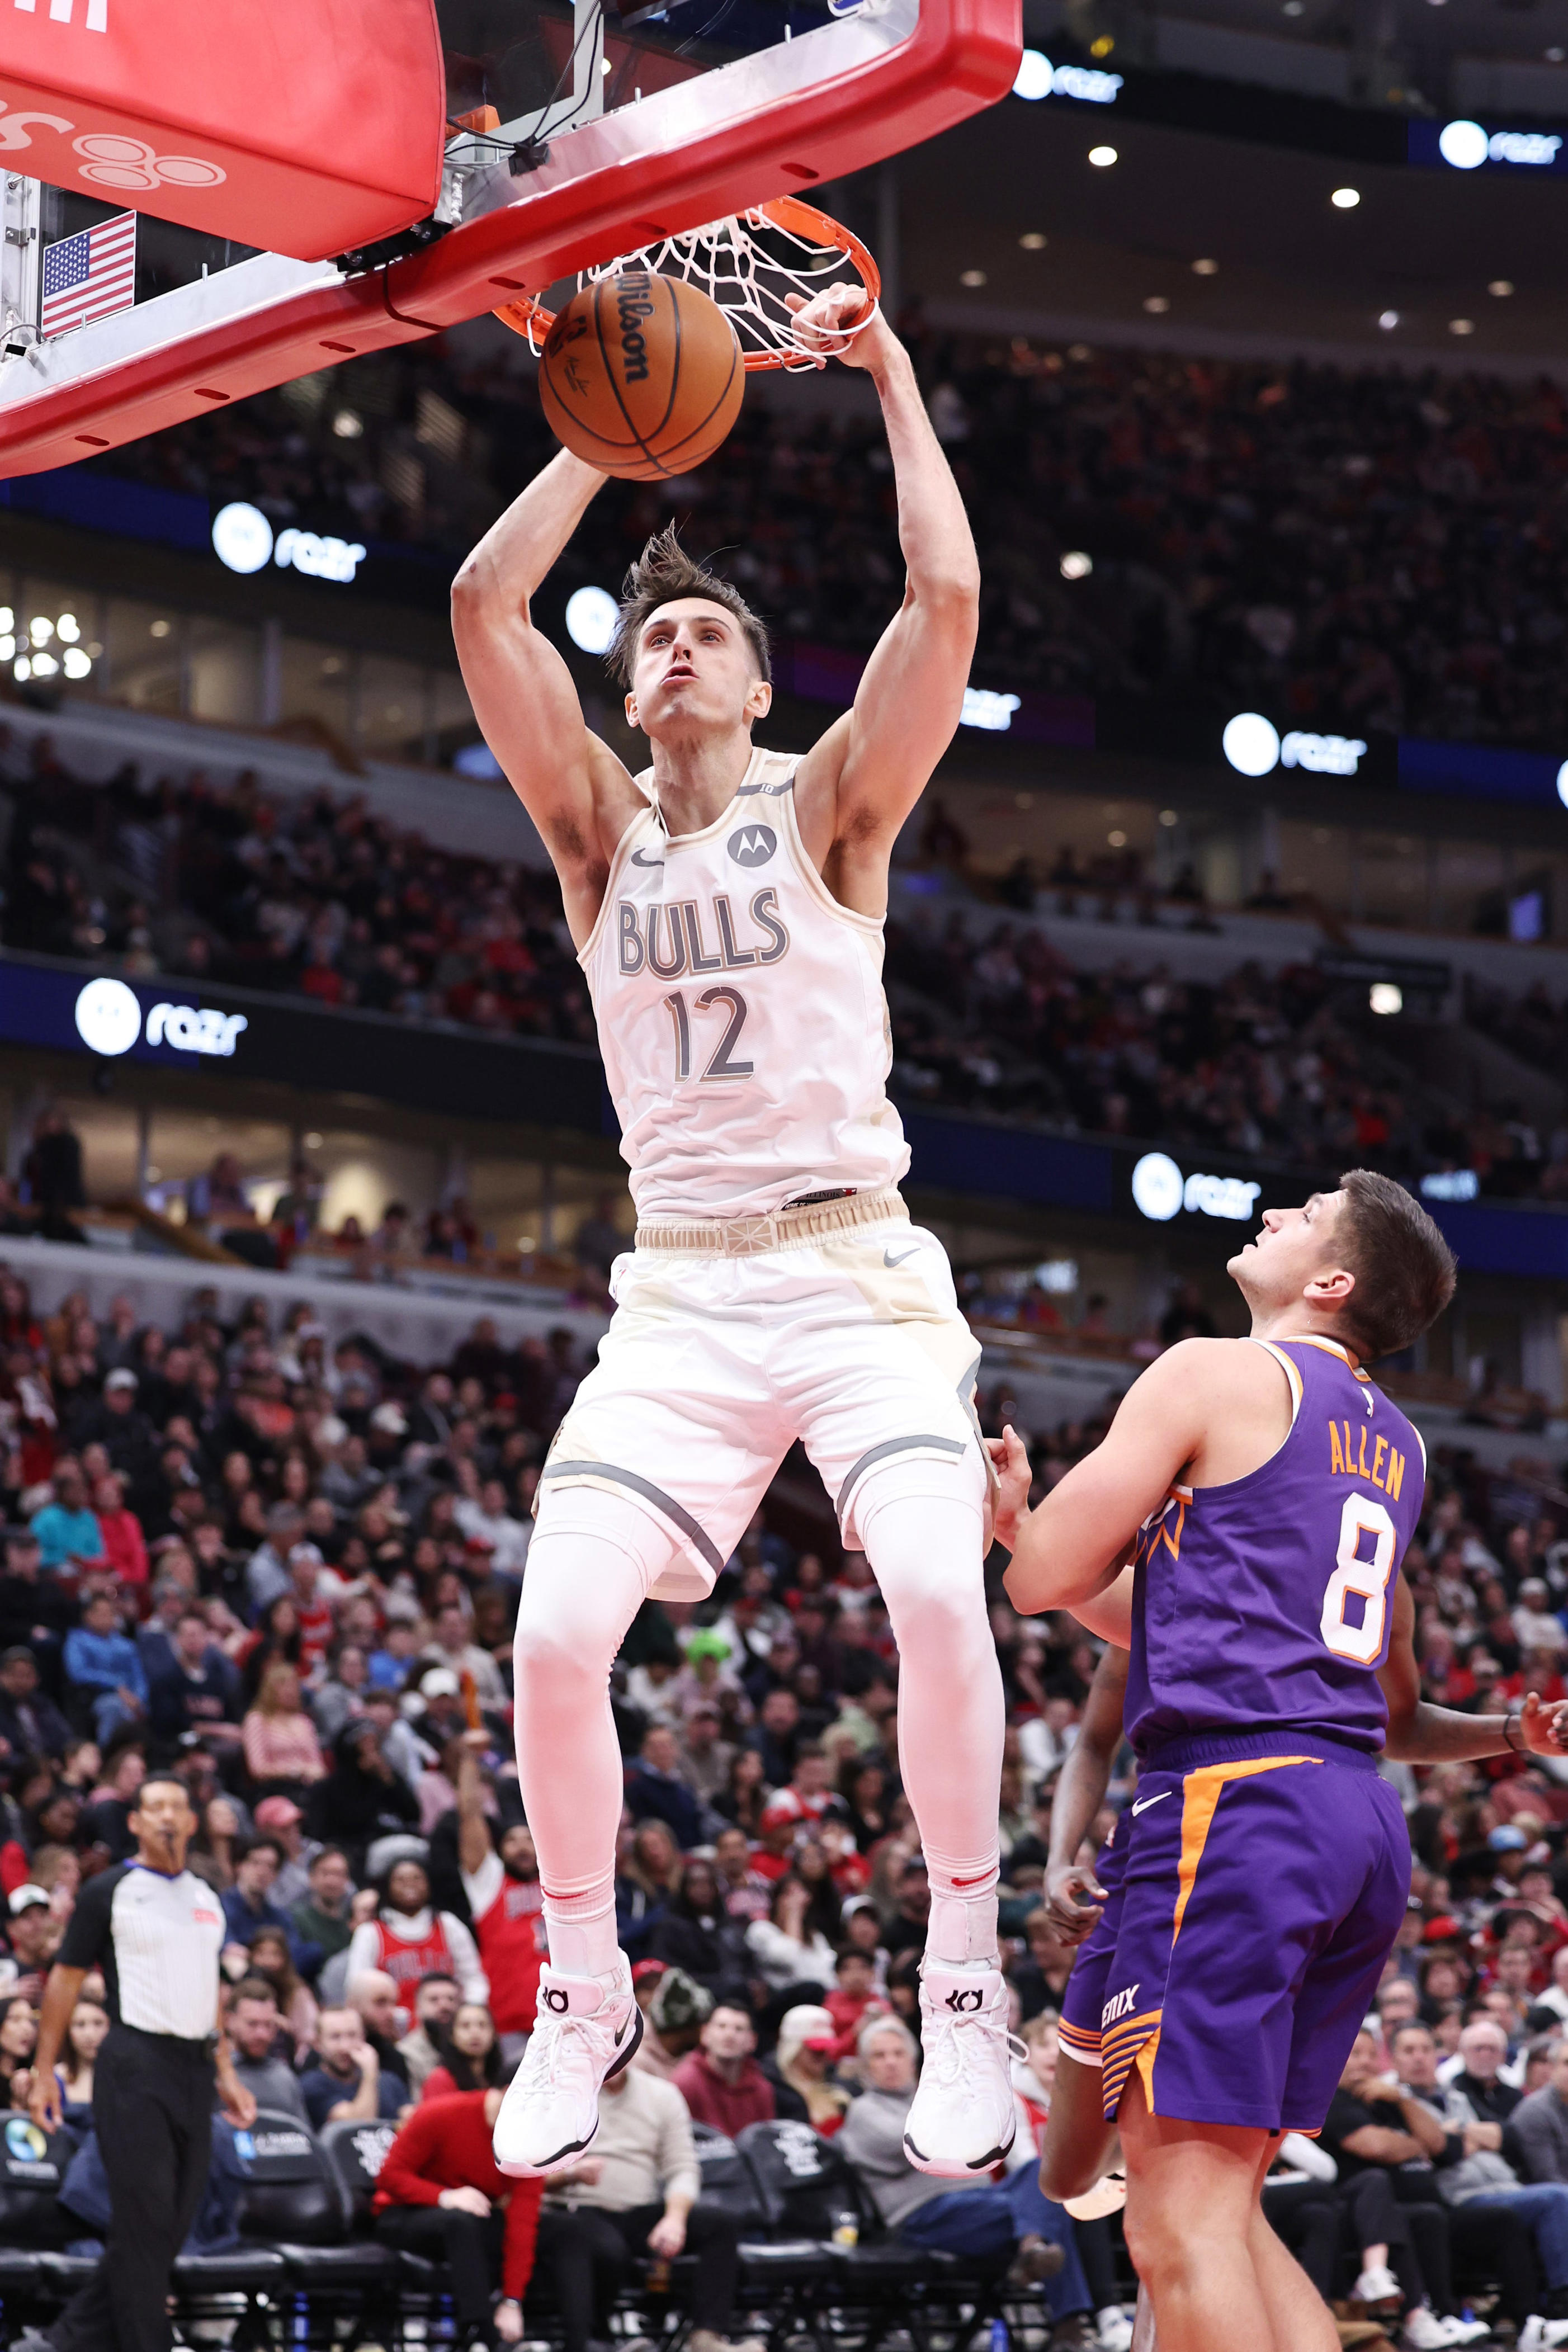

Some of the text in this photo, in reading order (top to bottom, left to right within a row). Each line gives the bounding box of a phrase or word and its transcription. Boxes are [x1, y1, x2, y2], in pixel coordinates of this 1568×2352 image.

[615, 272, 655, 385] Wilson
[759, 783, 774, 794] 10
[618, 887, 790, 981] BULLS
[663, 985, 755, 1084] 12
[1329, 1420, 1405, 1502] ALLEN
[1320, 1491, 1396, 1665] 8
